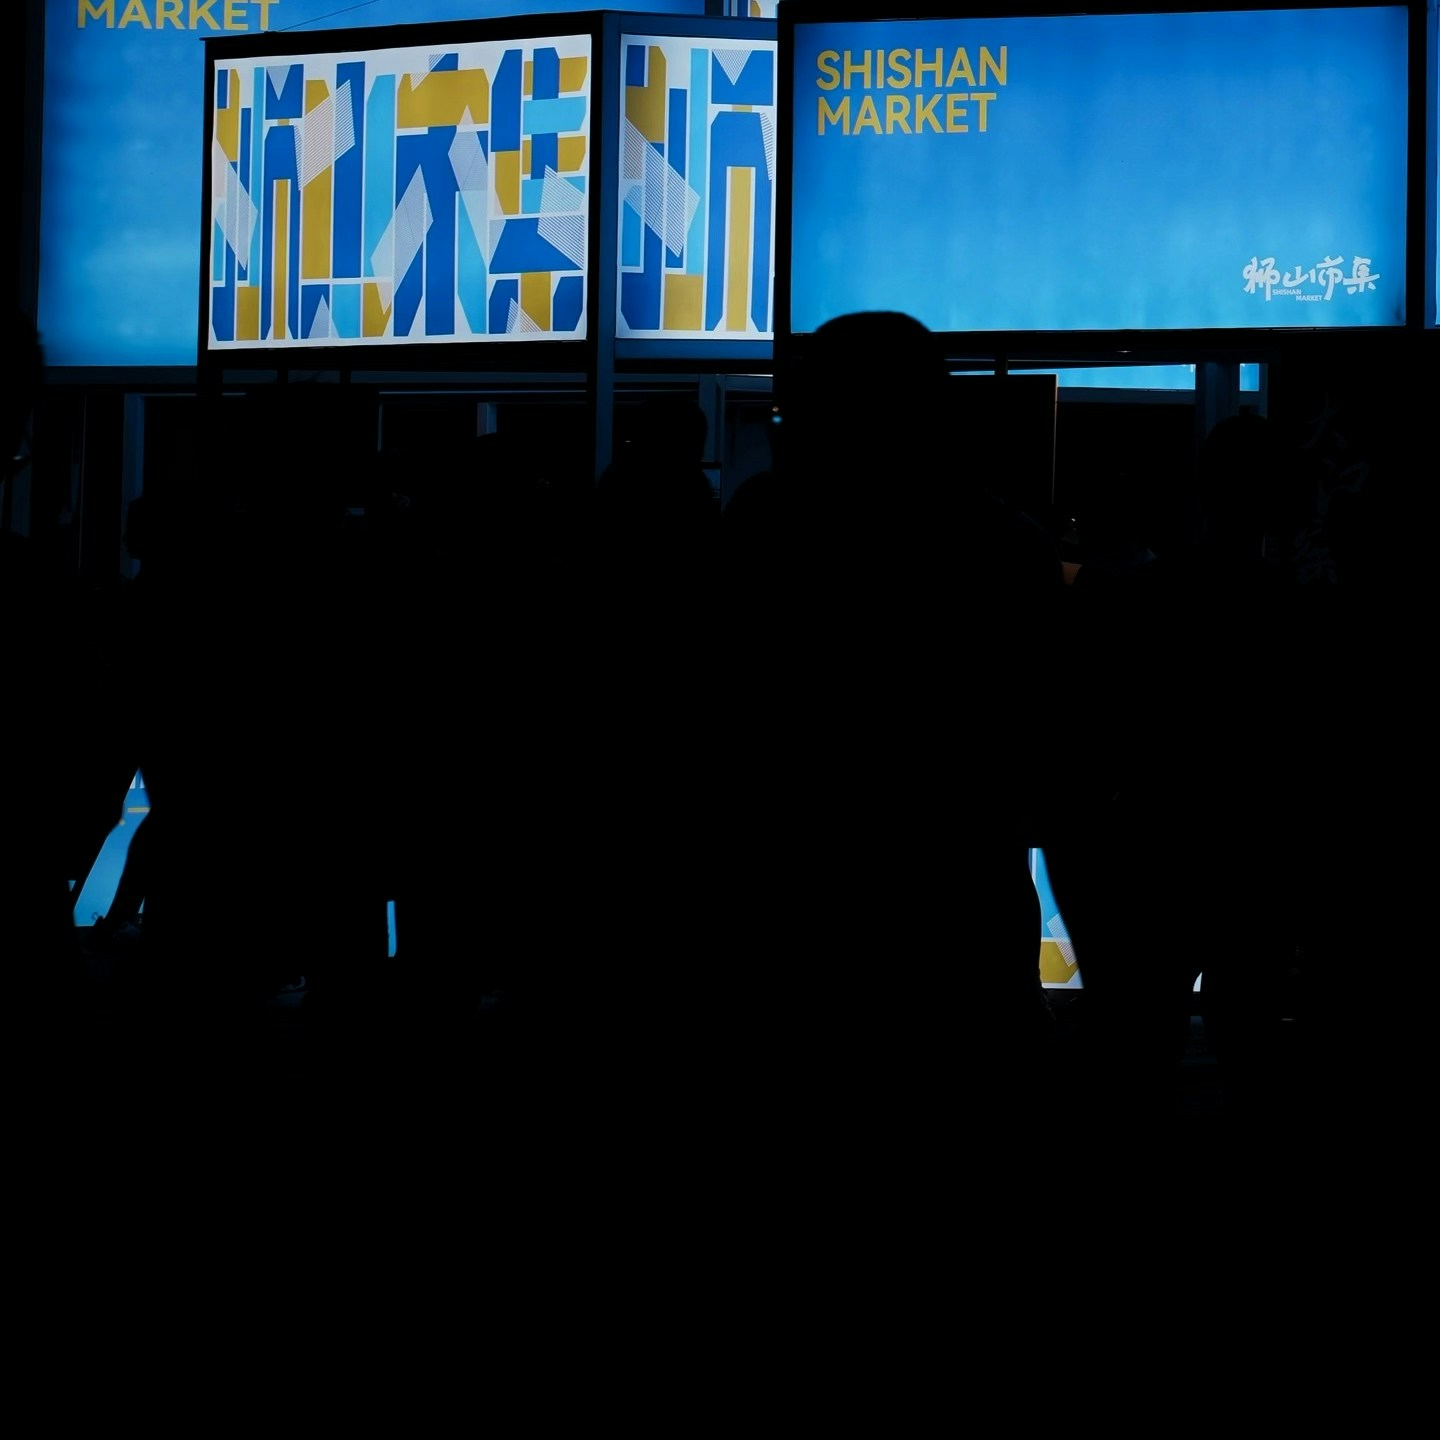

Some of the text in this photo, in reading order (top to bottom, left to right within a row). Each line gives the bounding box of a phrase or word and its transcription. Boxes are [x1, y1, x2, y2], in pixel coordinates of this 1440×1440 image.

[816, 45, 1008, 91] SHISHAN
[817, 92, 997, 136] MARKET
[1242, 255, 1381, 301] 狮山市集
